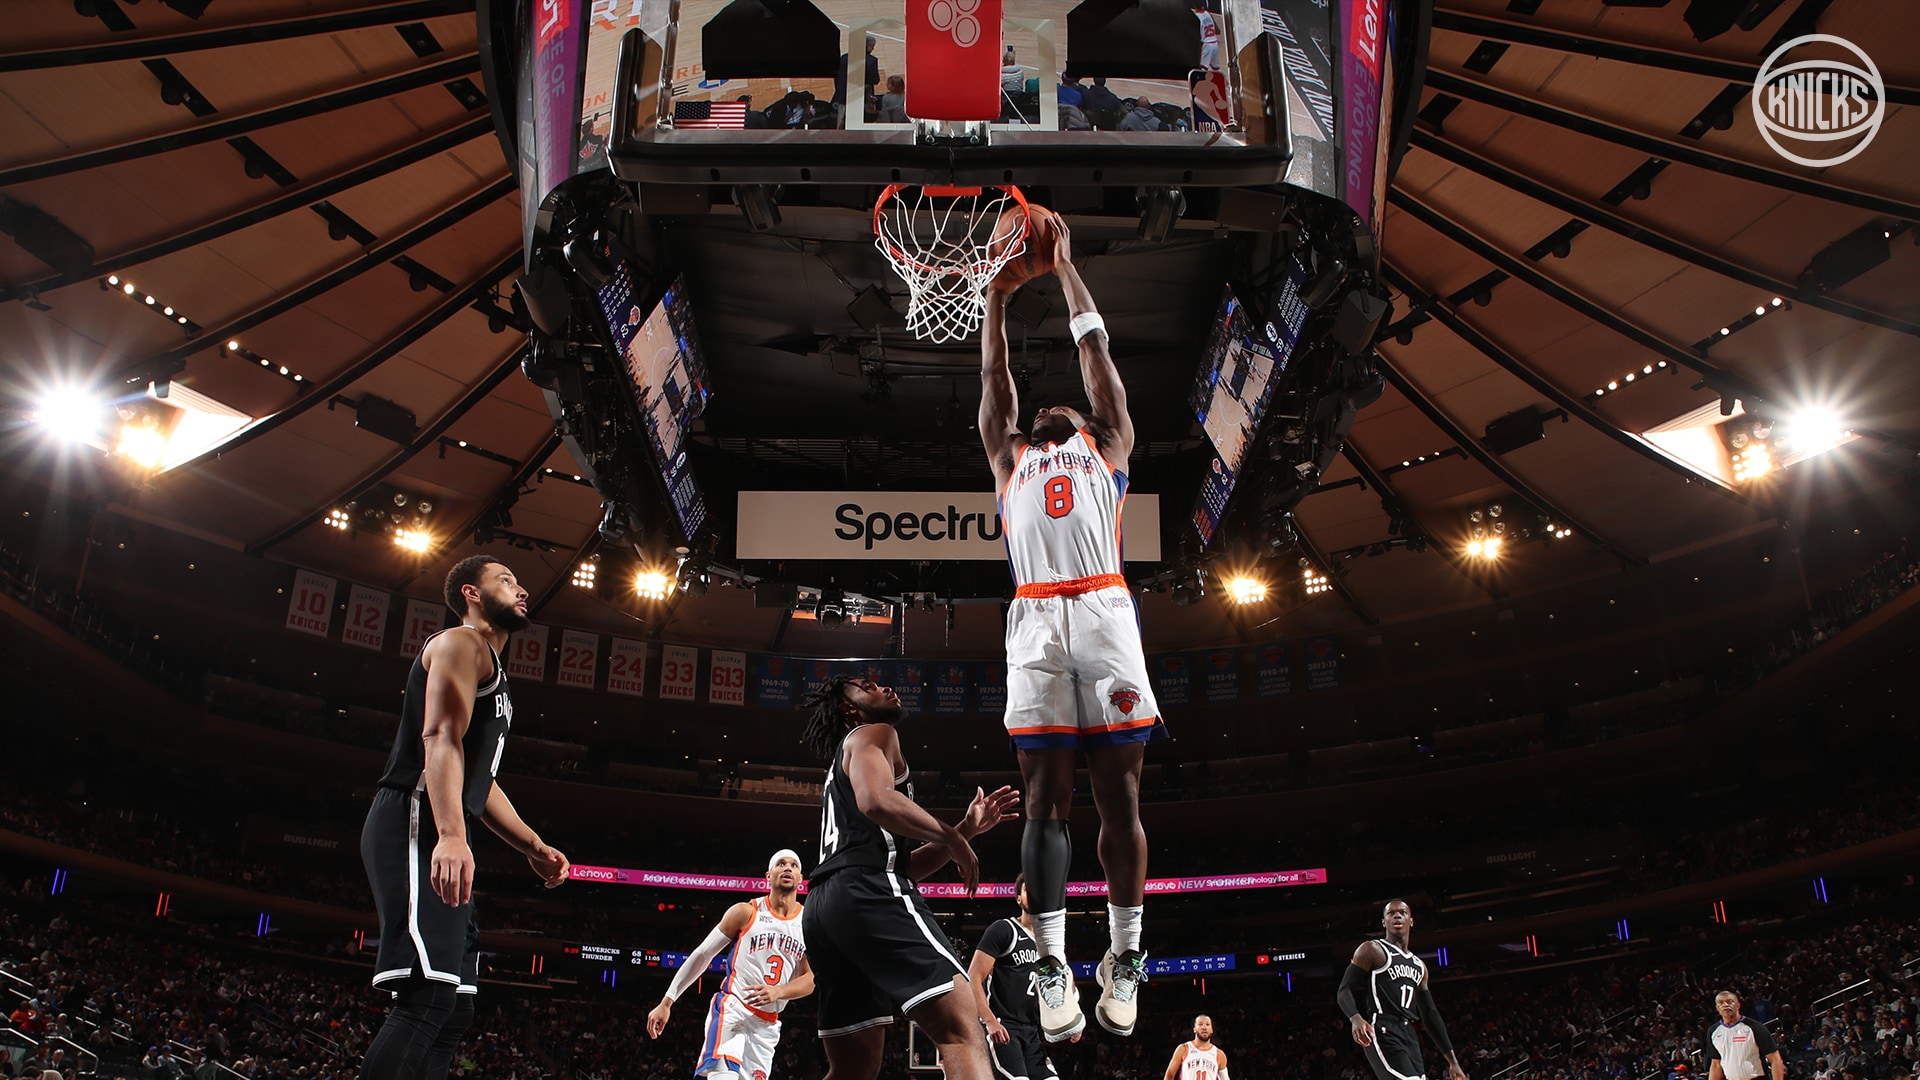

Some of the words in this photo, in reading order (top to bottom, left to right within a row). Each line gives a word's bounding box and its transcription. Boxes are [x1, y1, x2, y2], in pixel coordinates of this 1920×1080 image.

[1283, 46, 1328, 90] YORK
[1199, 122, 1217, 132] NBA
[1348, 84, 1366, 190] MOVING
[620, 323, 629, 338] 62
[1018, 458, 1051, 492] NEW
[1053, 449, 1096, 476] YORK
[1044, 475, 1074, 519] 8
[297, 588, 326, 616] 10
[289, 614, 327, 633] KNICKS
[353, 604, 381, 631] 12
[345, 628, 381, 647] KNICKS
[410, 618, 437, 640] 15
[515, 638, 541, 662] 19
[563, 647, 594, 671] 22
[509, 663, 543, 677] KNICKS
[612, 654, 641, 679] 24
[664, 661, 694, 683] 33
[560, 671, 593, 685] KNICKS
[610, 679, 642, 692] KNICKS
[712, 666, 744, 688] 613
[761, 679, 789, 688] 1969-70
[662, 685, 694, 697] KNICKS
[711, 690, 743, 702] KNICKS
[937, 686, 965, 694] 1952-53
[283, 833, 307, 844] BUD
[307, 838, 338, 849] LIGHT
[1486, 854, 1507, 864] BUD
[1508, 850, 1537, 861] LIGHT
[573, 868, 613, 879] Lenovo
[1178, 880, 1205, 889] NEW
[582, 946, 620, 955] MAVERICKS
[748, 932, 776, 955] NEW
[778, 933, 805, 962] YORK
[581, 953, 613, 961] THUNDER
[763, 954, 784, 986] 3
[1400, 984, 1414, 1009] 17
[1187, 1058, 1200, 1070] NEW
[1201, 1058, 1216, 1071] YORK
